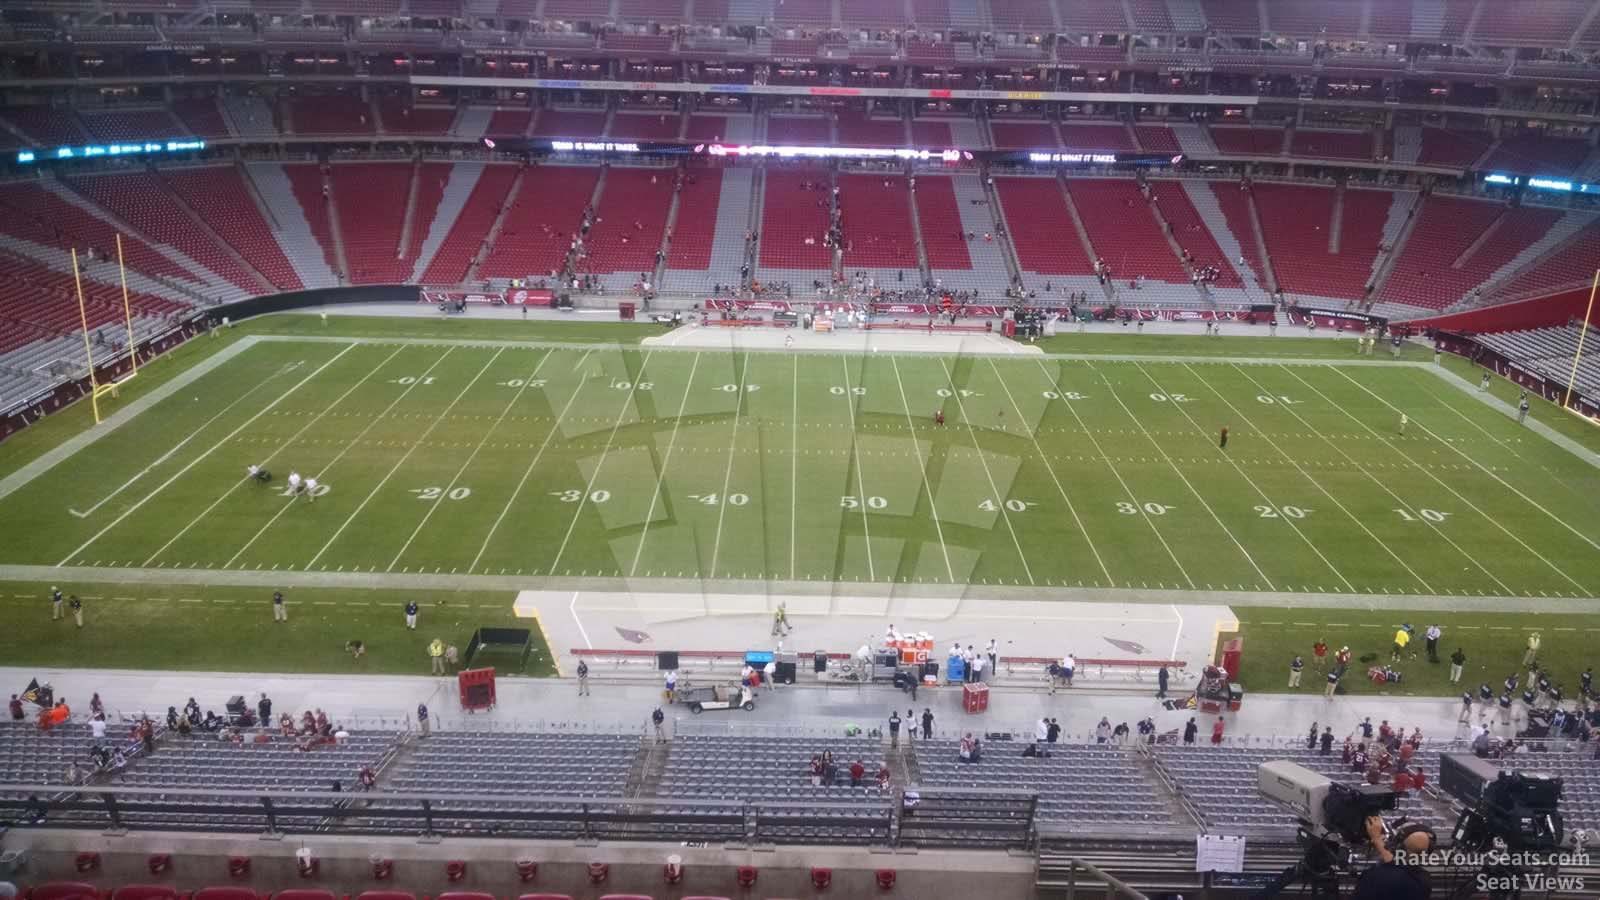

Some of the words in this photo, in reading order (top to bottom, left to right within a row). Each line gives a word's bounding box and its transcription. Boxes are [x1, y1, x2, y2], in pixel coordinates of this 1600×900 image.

[417, 487, 471, 500] 20
[560, 490, 610, 503] 30
[699, 494, 749, 506] 40
[840, 496, 887, 509] 50
[978, 499, 1026, 512] 40
[1115, 502, 1166, 515] 30
[1253, 505, 1305, 518] 20
[1392, 508, 1445, 521] 10
